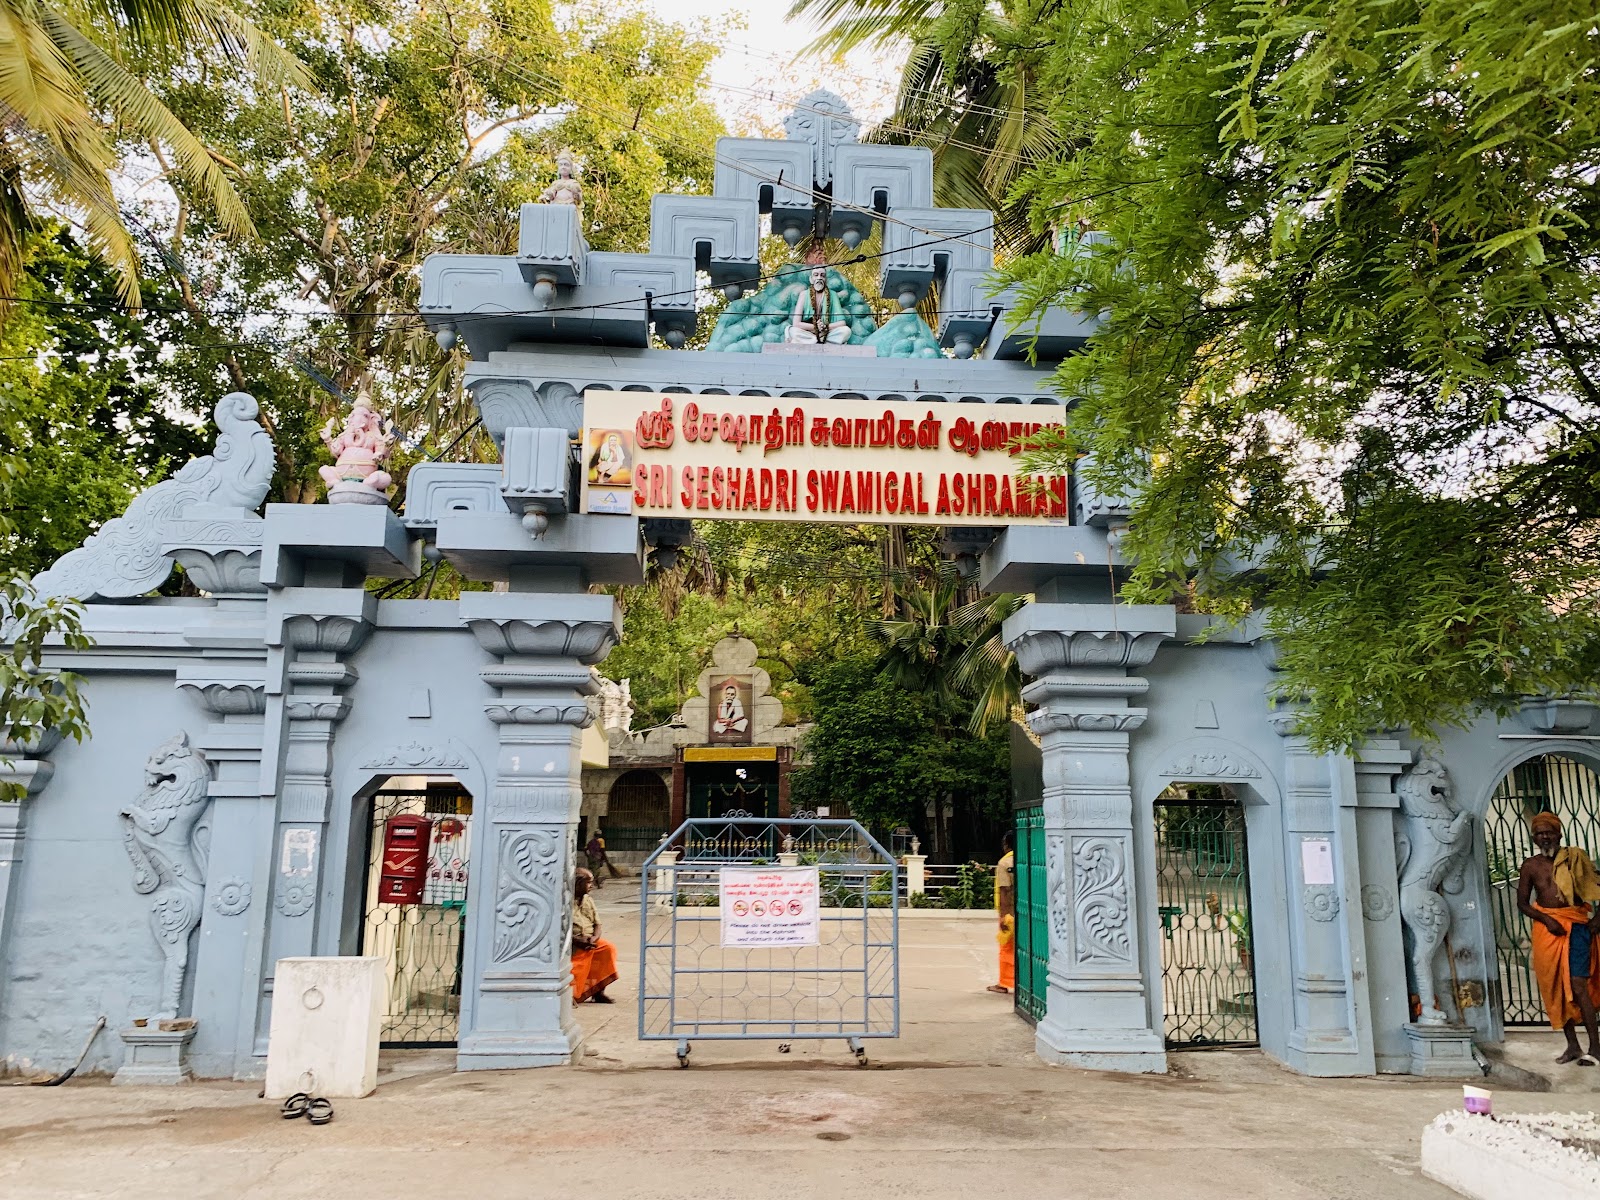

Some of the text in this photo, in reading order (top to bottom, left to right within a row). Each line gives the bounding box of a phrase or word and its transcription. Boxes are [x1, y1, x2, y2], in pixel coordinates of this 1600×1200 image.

[682, 402, 804, 457] சேஷாத்ரி
[810, 409, 942, 449] சுவாமிகள்
[634, 463, 1067, 518] SRI SESHADRI SWAMIGAL ASHRAMAM
